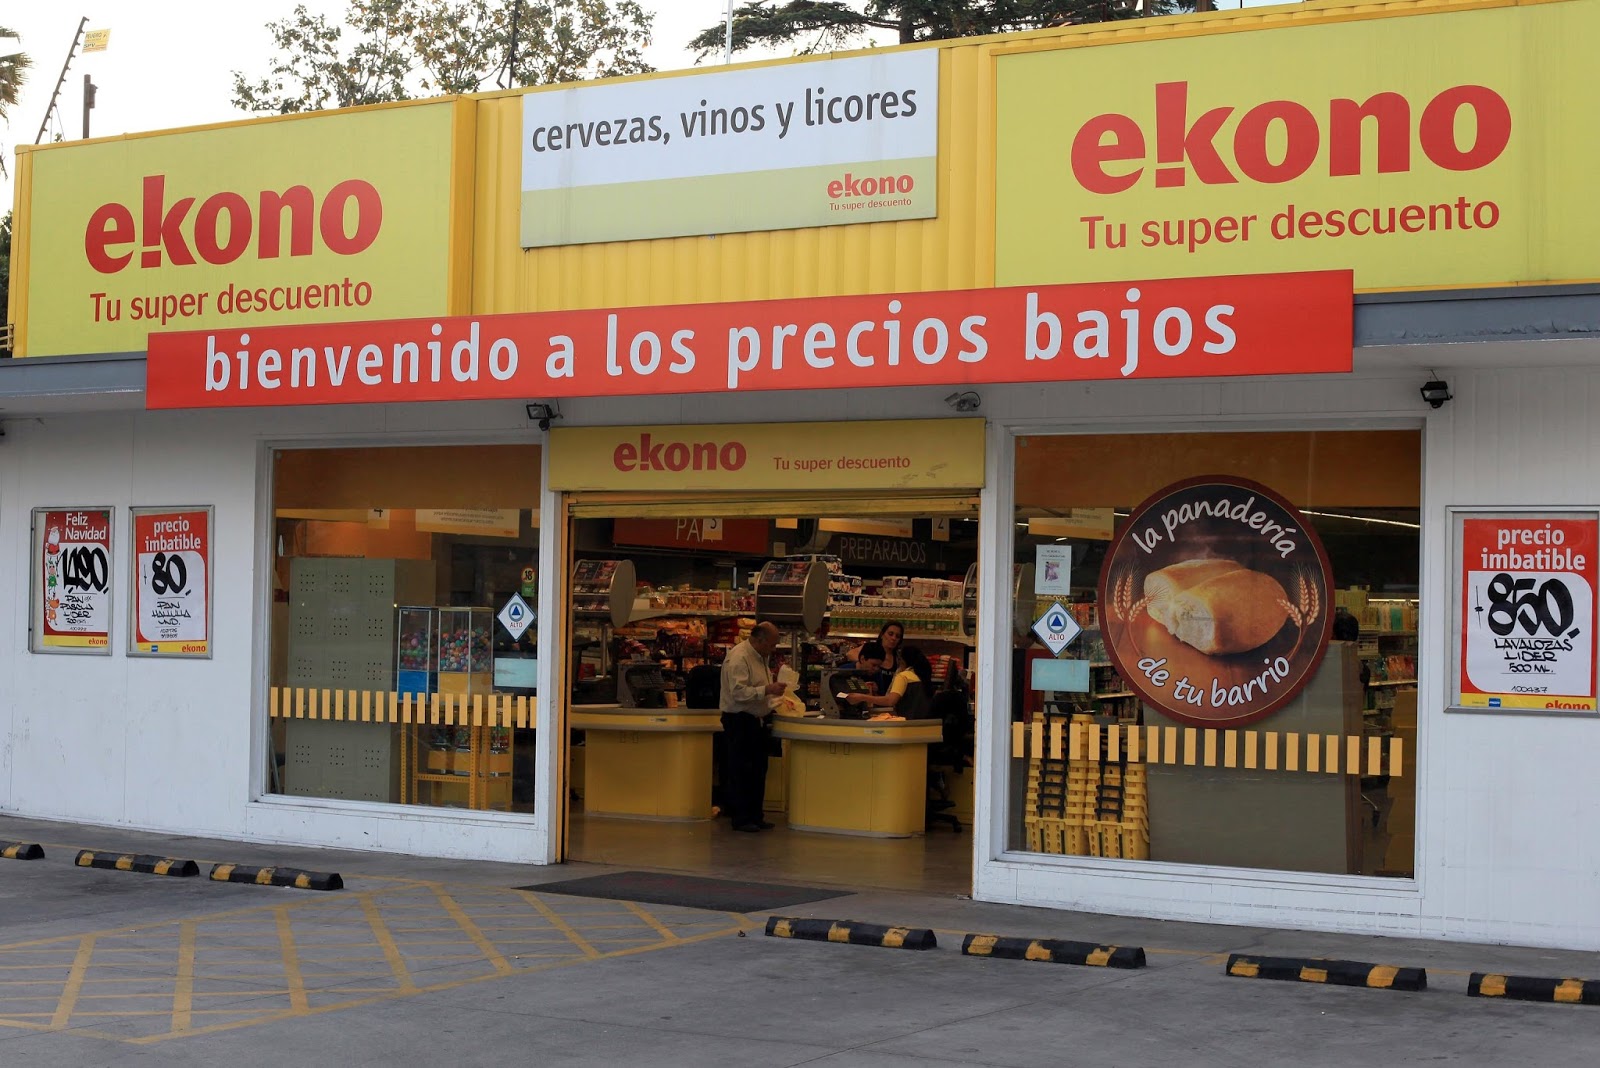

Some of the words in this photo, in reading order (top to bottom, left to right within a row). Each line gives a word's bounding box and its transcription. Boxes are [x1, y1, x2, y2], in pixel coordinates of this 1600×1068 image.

[532, 115, 670, 153] cervezas,
[681, 99, 765, 139] vinos
[776, 101, 794, 140] y
[805, 87, 917, 127] licores
[1071, 81, 1512, 195] ekono
[827, 173, 914, 199] ekono
[829, 202, 840, 211] Tu
[841, 201, 865, 212] super
[867, 198, 912, 208] descuento
[85, 174, 382, 274] ekono
[1080, 215, 1127, 250] Tu
[1140, 214, 1258, 253] super
[1270, 196, 1500, 241] descuento
[90, 292, 121, 322] Tu
[130, 290, 209, 326] super
[217, 277, 373, 315] descuento
[205, 321, 519, 392] bienvenido
[545, 334, 575, 379] a
[606, 313, 697, 377] los
[728, 300, 989, 389] precios
[1025, 287, 1238, 377] bajos
[613, 433, 747, 472] ekono
[773, 456, 790, 471] Tu
[794, 458, 833, 473] super
[837, 455, 911, 470] descuento
[65, 512, 89, 527] Feliz
[153, 516, 190, 537] precio
[1132, 527, 1163, 554] la
[1161, 496, 1297, 559] panadería
[65, 526, 107, 541] Navidad
[145, 535, 202, 552] imbatible
[1497, 523, 1565, 550] precio
[839, 536, 926, 564] PREPARADOS
[1481, 548, 1586, 571] imbatible
[65, 594, 84, 604] PAN
[157, 601, 181, 610] PAN
[1048, 633, 1065, 641] ALTO
[1493, 638, 1574, 652] LAVALOZAS
[181, 644, 206, 653] ekono
[1503, 651, 1558, 662] LIDER
[1509, 662, 1532, 673] 500
[1137, 656, 1170, 687] de
[1173, 675, 1205, 707] tu
[1210, 655, 1290, 708] barrio
